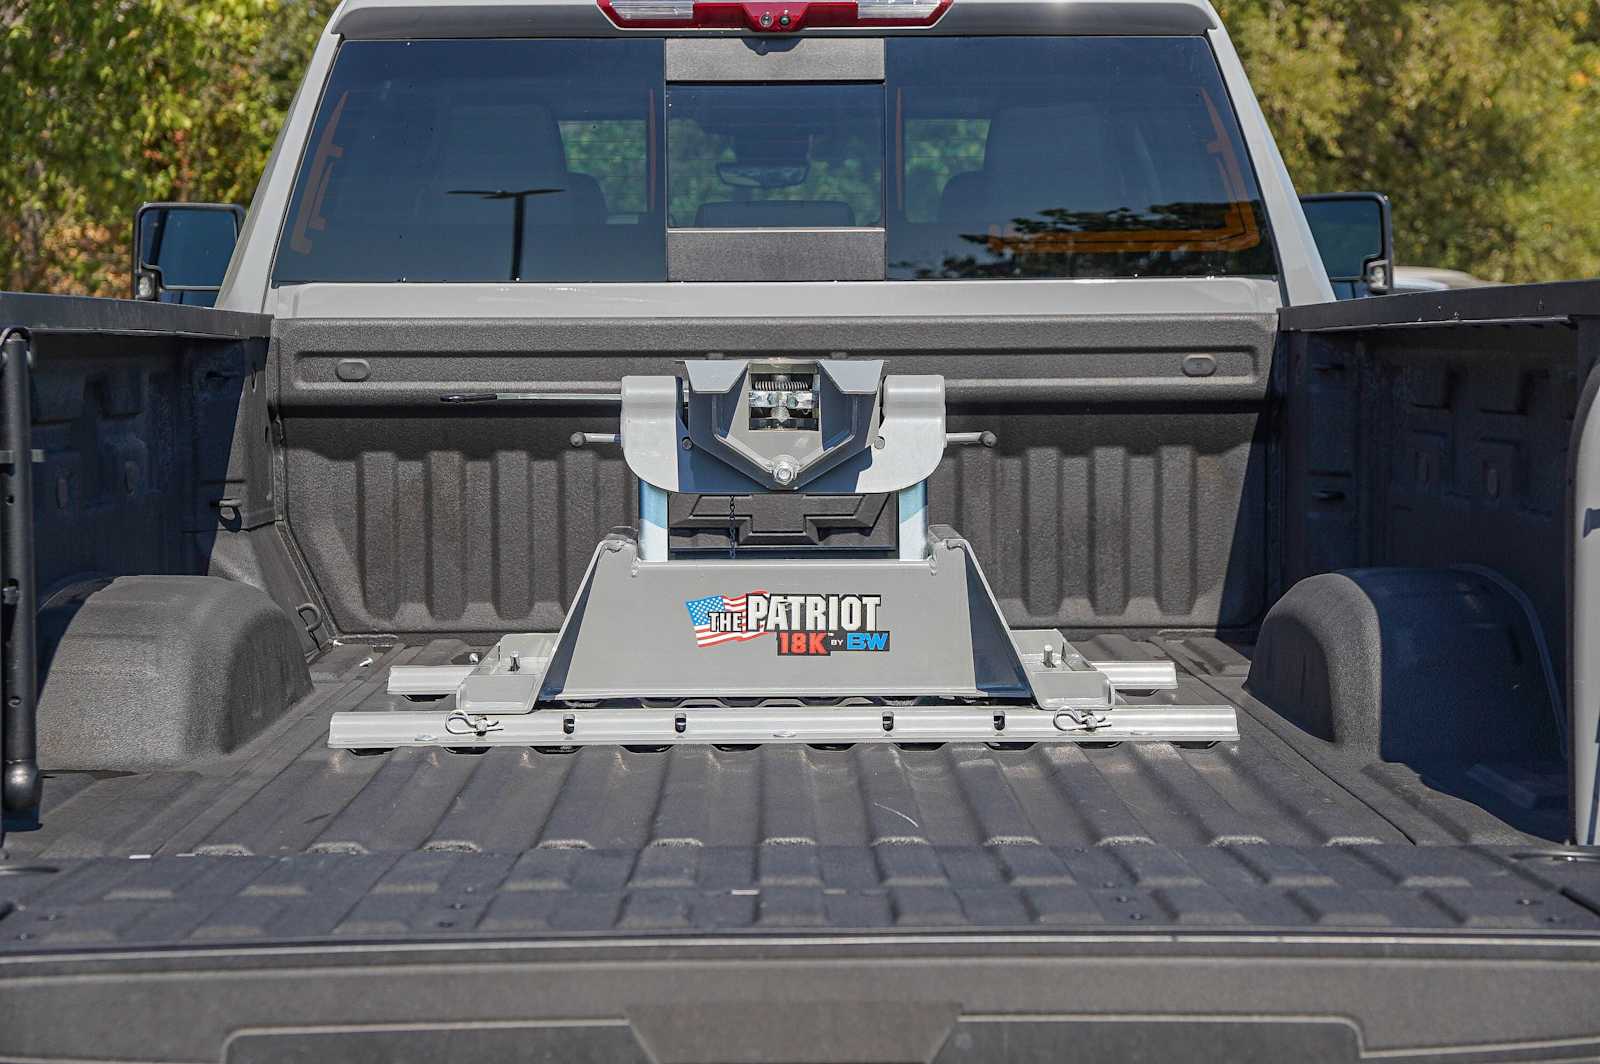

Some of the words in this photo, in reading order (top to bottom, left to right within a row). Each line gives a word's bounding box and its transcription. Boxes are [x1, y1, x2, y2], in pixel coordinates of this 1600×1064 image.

[708, 612, 743, 632] THE
[746, 594, 881, 632] PATRIOT
[779, 632, 828, 654] 18K
